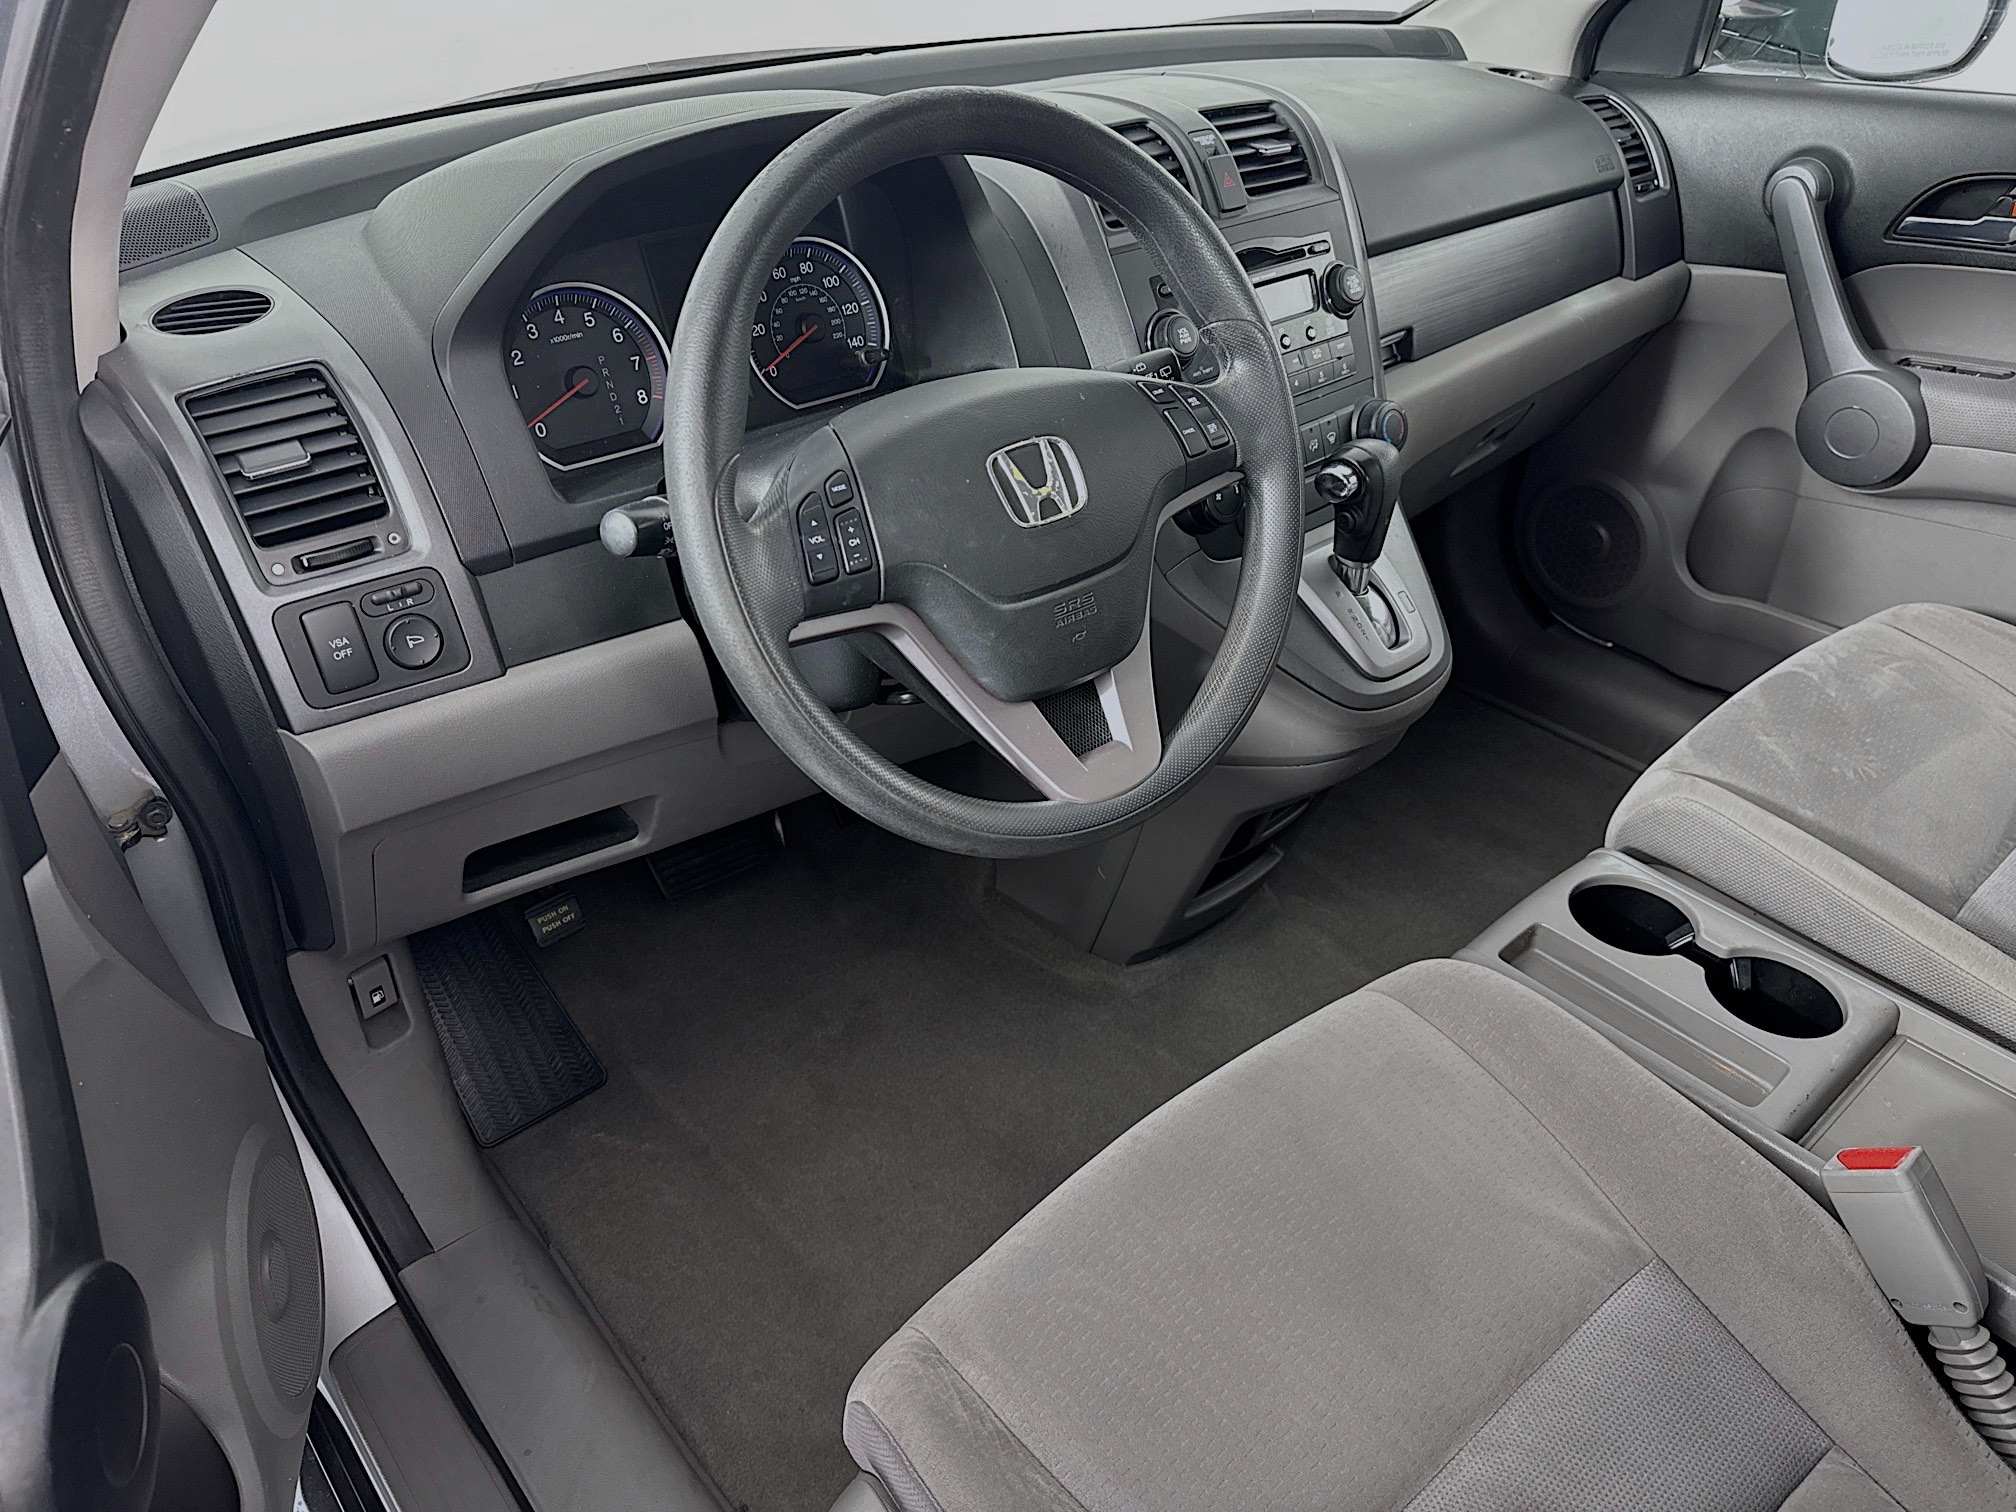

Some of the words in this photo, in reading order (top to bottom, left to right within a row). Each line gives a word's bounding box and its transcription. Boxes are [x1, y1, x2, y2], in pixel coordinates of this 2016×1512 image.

[772, 266, 787, 280] 60
[799, 261, 814, 275] 80
[822, 275, 840, 289] 100
[788, 289, 798, 297] 100
[554, 309, 565, 324] 4
[841, 302, 859, 316] 120
[584, 312, 595, 327] 5
[831, 318, 841, 326] 200
[526, 323, 539, 339] 3
[612, 327, 624, 343] 6
[752, 323, 766, 337] 20
[847, 335, 864, 349] 140
[511, 350, 524, 366] 2
[630, 355, 640, 371] 7
[769, 365, 778, 377] 0
[512, 384, 519, 399] 1
[598, 356, 605, 364] P
[602, 368, 610, 376] R
[606, 380, 614, 389] N
[610, 392, 617, 401] D
[614, 405, 621, 414] 2
[619, 415, 624, 425] 1
[636, 389, 648, 404] 8
[535, 422, 547, 438] 0
[808, 535, 826, 545] VOL
[387, 604, 394, 612] L
[406, 598, 414, 606] R
[1054, 591, 1095, 617] SRS
[1055, 605, 1098, 629] AIRBAG
[328, 636, 350, 649] VSA
[333, 648, 353, 661] OFF
[537, 911, 557, 924] PUSH
[558, 904, 569, 914] ON
[541, 920, 561, 933] PUSH
[562, 912, 576, 923] OFF
